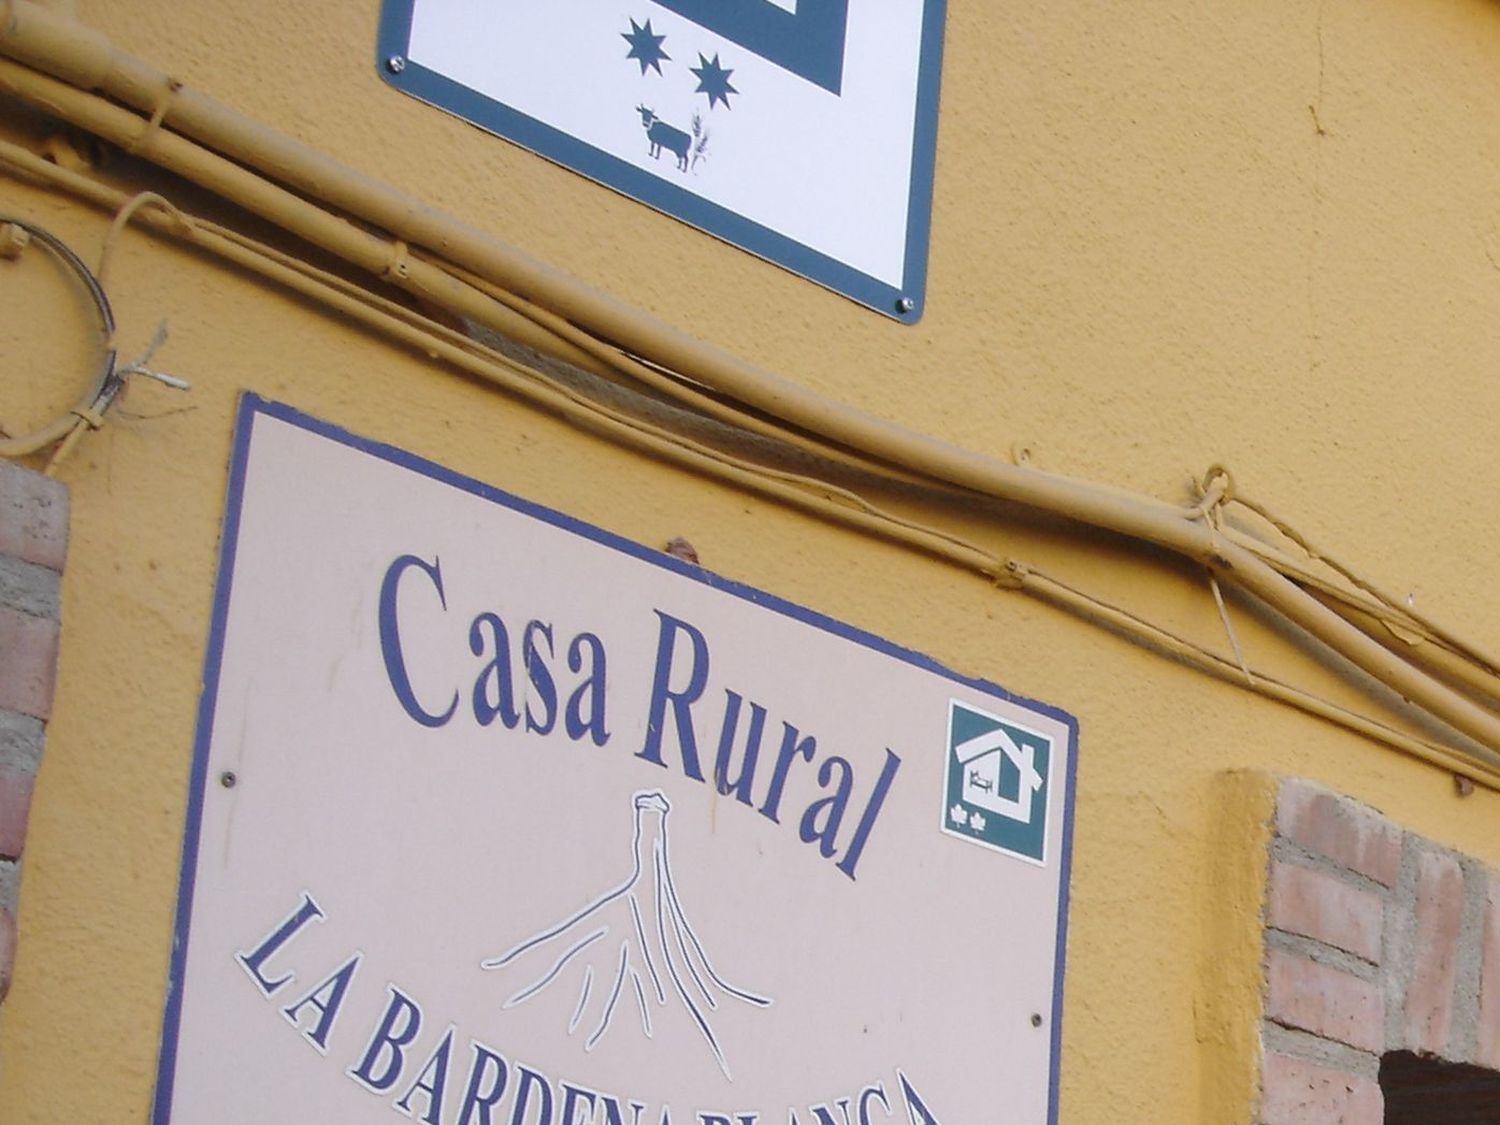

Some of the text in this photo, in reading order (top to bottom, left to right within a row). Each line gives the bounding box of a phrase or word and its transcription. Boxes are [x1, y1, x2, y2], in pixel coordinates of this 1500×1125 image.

[378, 554, 902, 881] Casa Rural
[238, 893, 361, 1052] LA
